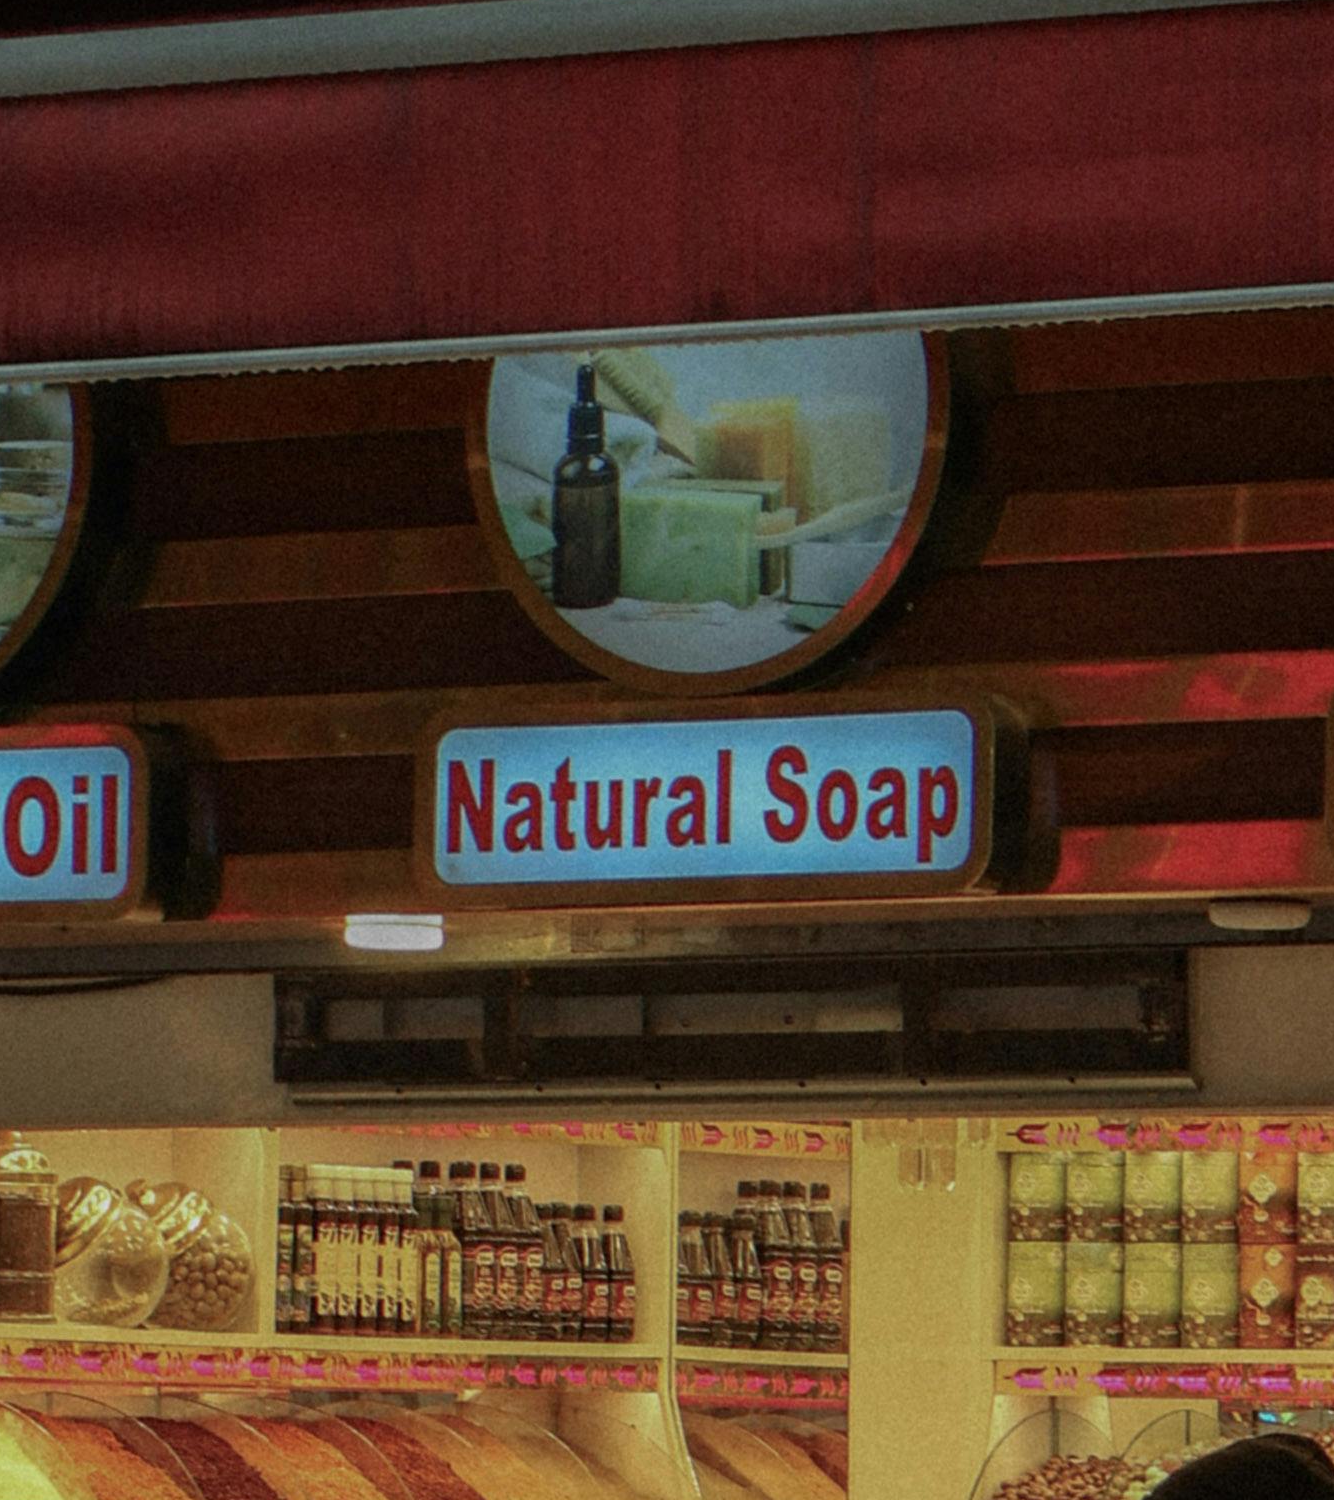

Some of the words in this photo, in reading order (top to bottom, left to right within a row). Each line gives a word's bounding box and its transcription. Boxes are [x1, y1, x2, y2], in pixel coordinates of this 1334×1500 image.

[5, 777, 119, 877] Oil
[449, 752, 733, 854] Natural
[766, 747, 960, 863] Soap
